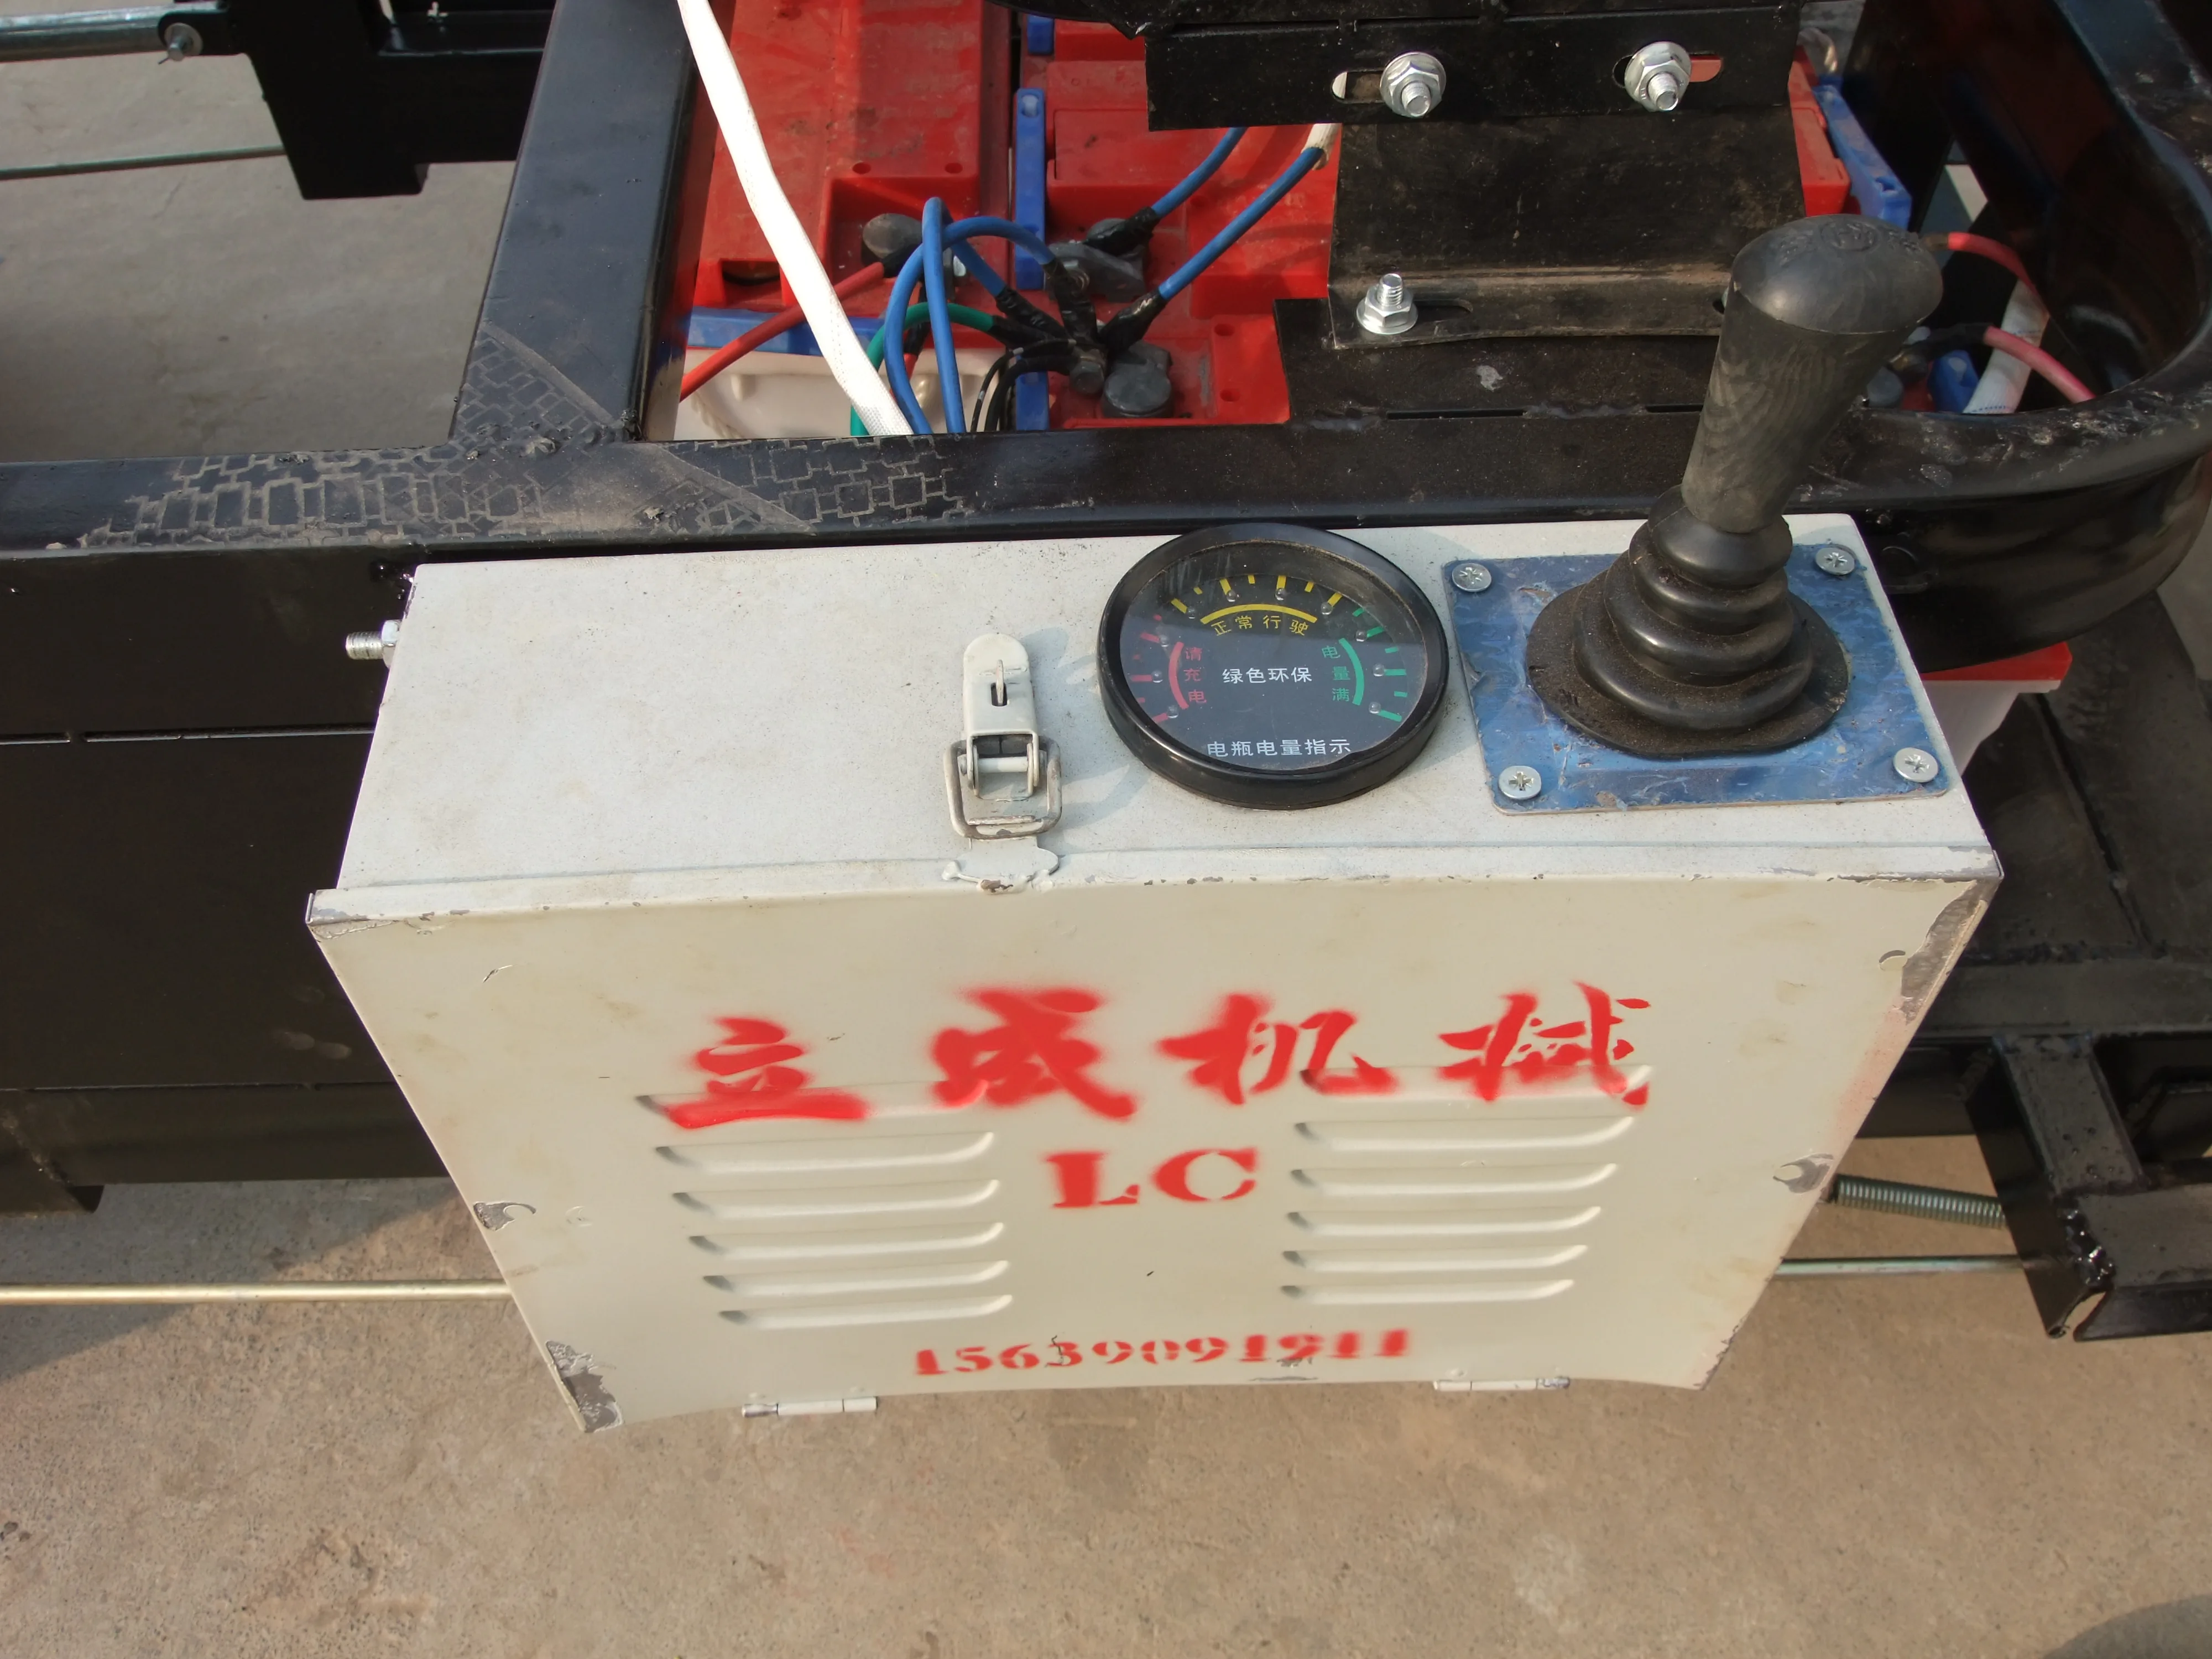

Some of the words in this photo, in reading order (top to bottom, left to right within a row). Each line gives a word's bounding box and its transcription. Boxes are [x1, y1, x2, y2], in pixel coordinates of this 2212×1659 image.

[1211, 615, 1308, 636] 正常行驶
[1183, 646, 1207, 703] 请充电
[1222, 667, 1312, 684] 绿色环保
[1322, 645, 1350, 702] 电量满
[1207, 739, 1351, 758] 电瓶电量指示
[1043, 1146, 1259, 1210] LC
